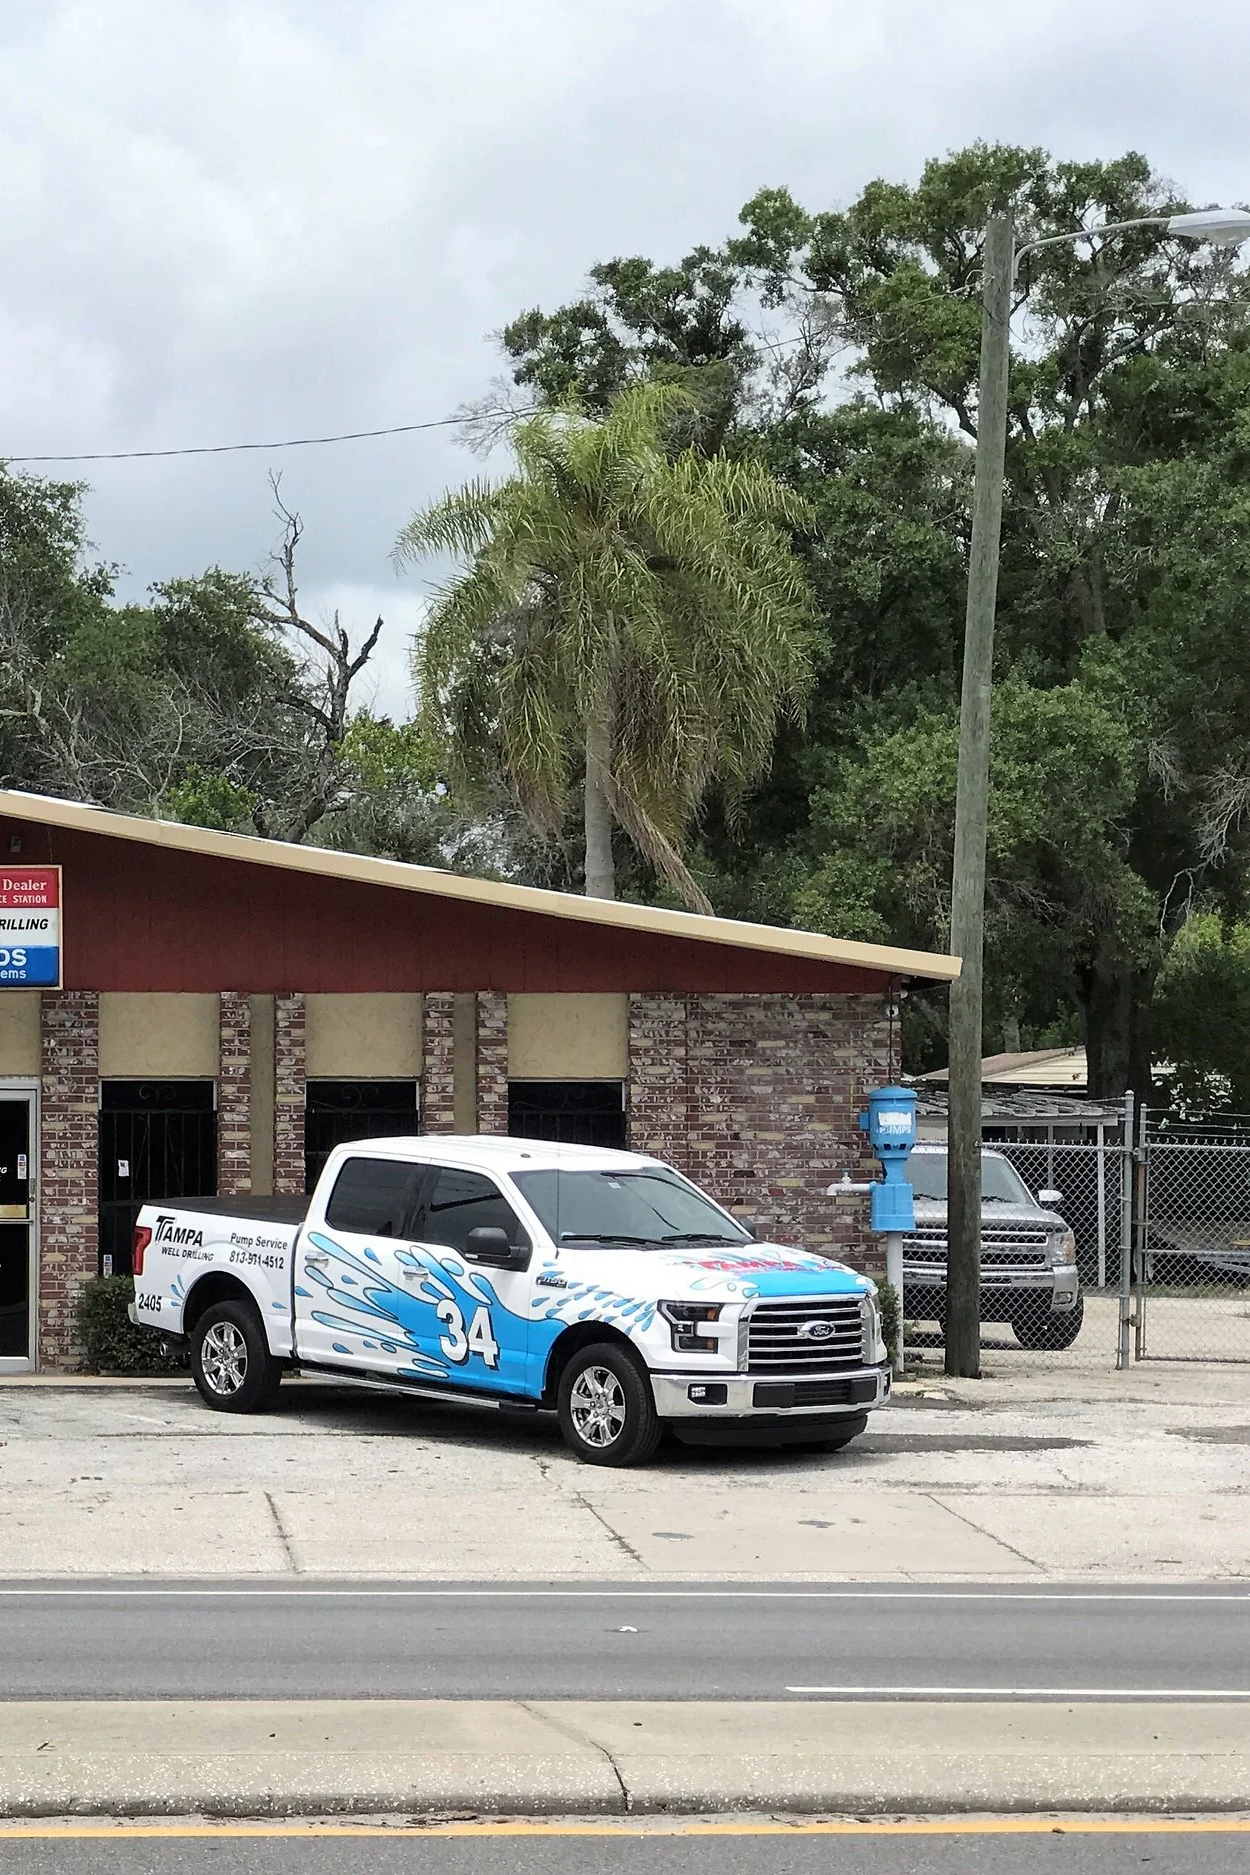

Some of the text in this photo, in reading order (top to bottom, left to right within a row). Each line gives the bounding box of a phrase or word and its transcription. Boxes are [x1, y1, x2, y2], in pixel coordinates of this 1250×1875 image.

[3, 879, 47, 891] Dealer
[13, 895, 47, 903] STATION
[155, 1215, 203, 1246] TAMPA
[230, 1233, 288, 1250] Pump Service
[161, 1247, 215, 1262] WELL DRILLING
[229, 1250, 284, 1269] 813-971-4512
[138, 1293, 163, 1312] 2405
[436, 1298, 500, 1370] 34
